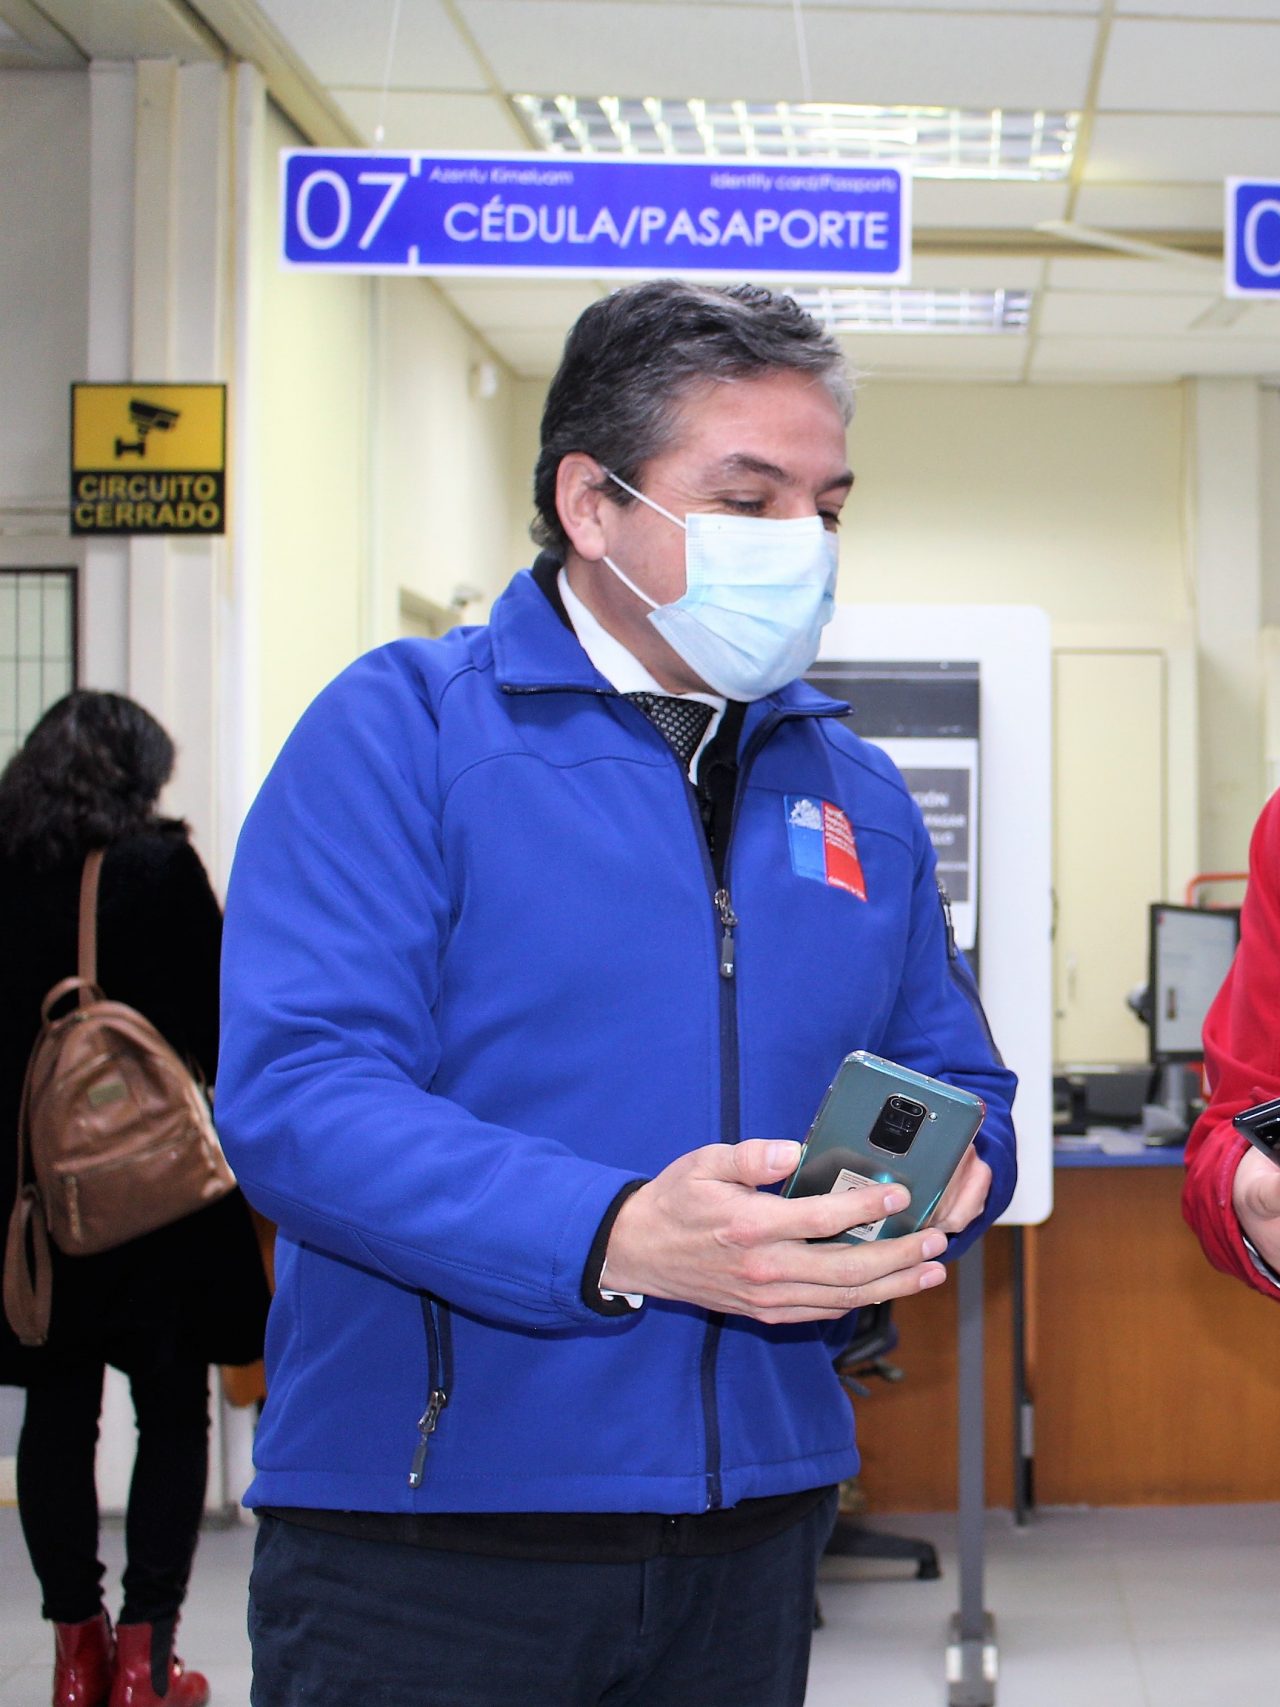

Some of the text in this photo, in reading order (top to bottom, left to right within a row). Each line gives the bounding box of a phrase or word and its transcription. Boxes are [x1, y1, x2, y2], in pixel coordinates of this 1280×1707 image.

[295, 168, 408, 250] 07
[443, 193, 889, 250] CÉDULA/PASAPORTE
[78, 474, 218, 501] CIRCUITO
[74, 501, 221, 528] CERRADO
